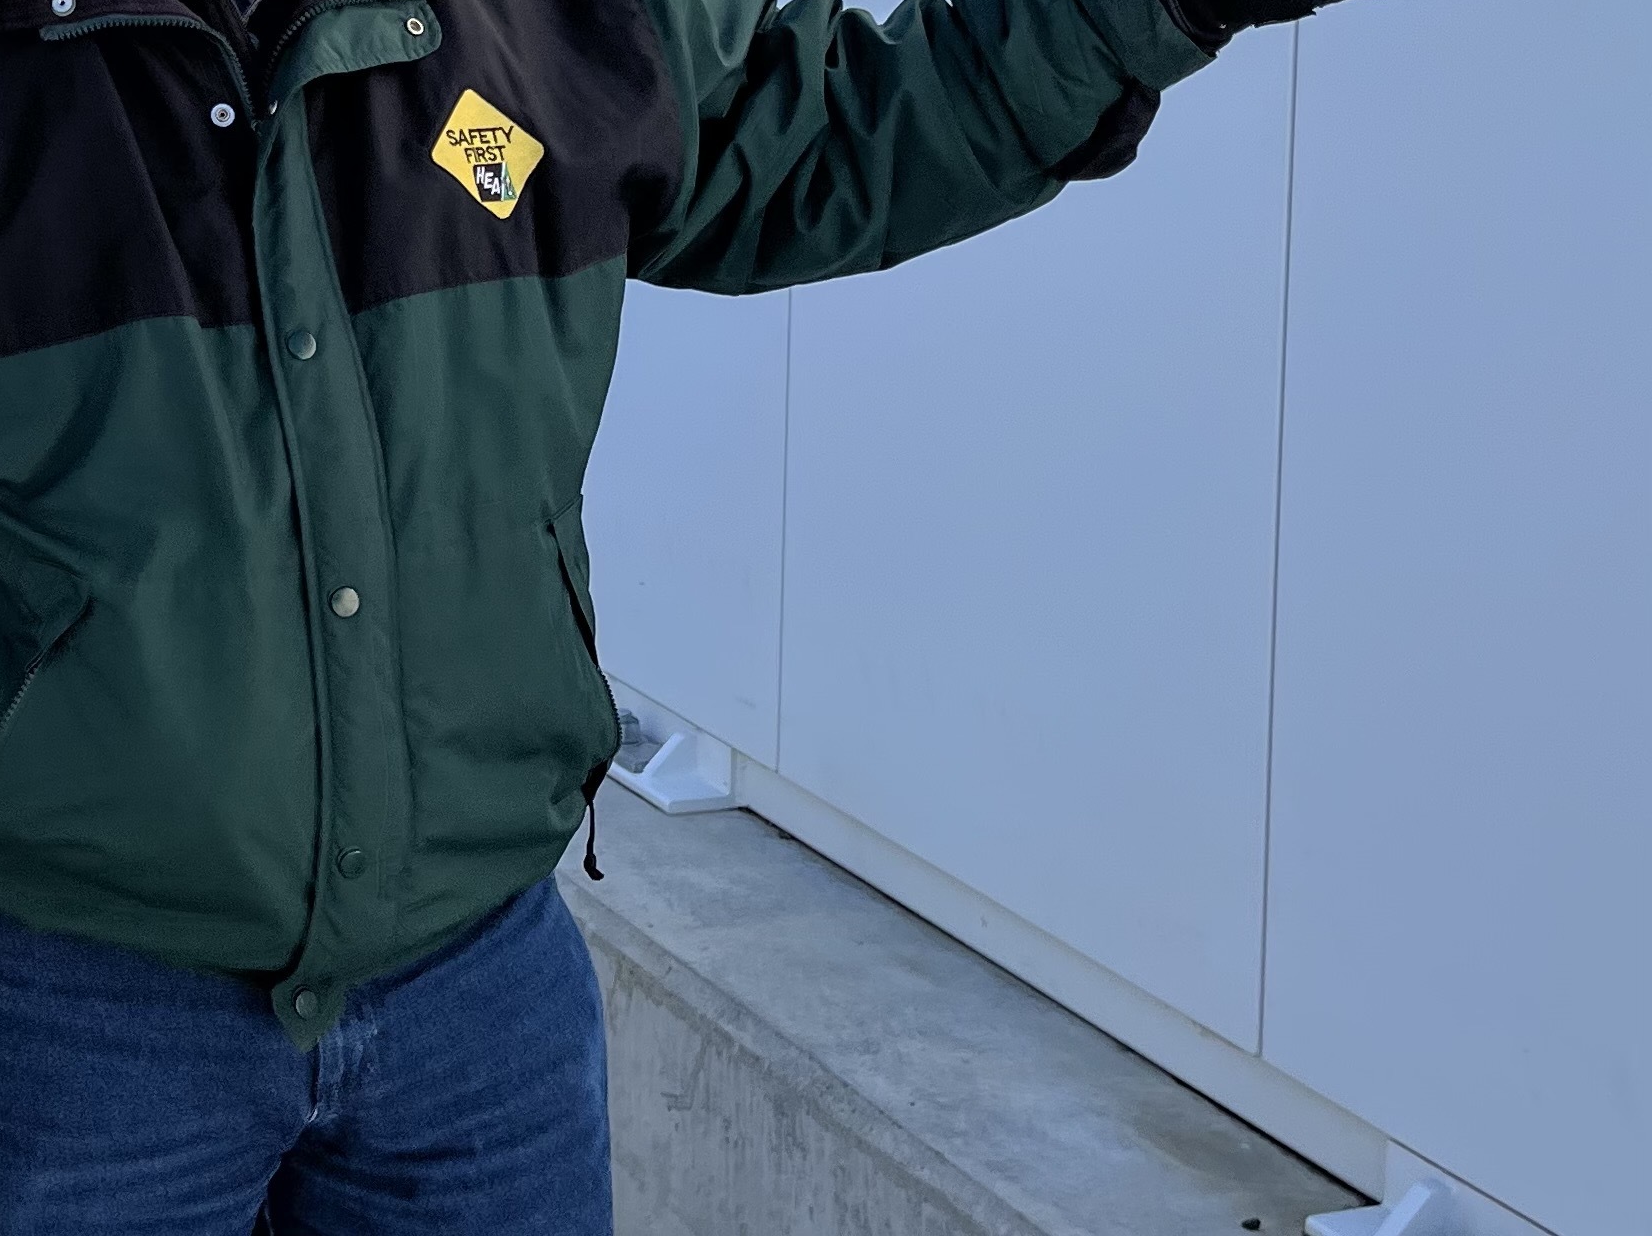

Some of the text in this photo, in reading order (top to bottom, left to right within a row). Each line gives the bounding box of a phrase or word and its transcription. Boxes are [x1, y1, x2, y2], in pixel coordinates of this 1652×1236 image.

[446, 125, 514, 146] SAFETY
[464, 145, 506, 164] FIRST
[476, 166, 501, 195] HEA
